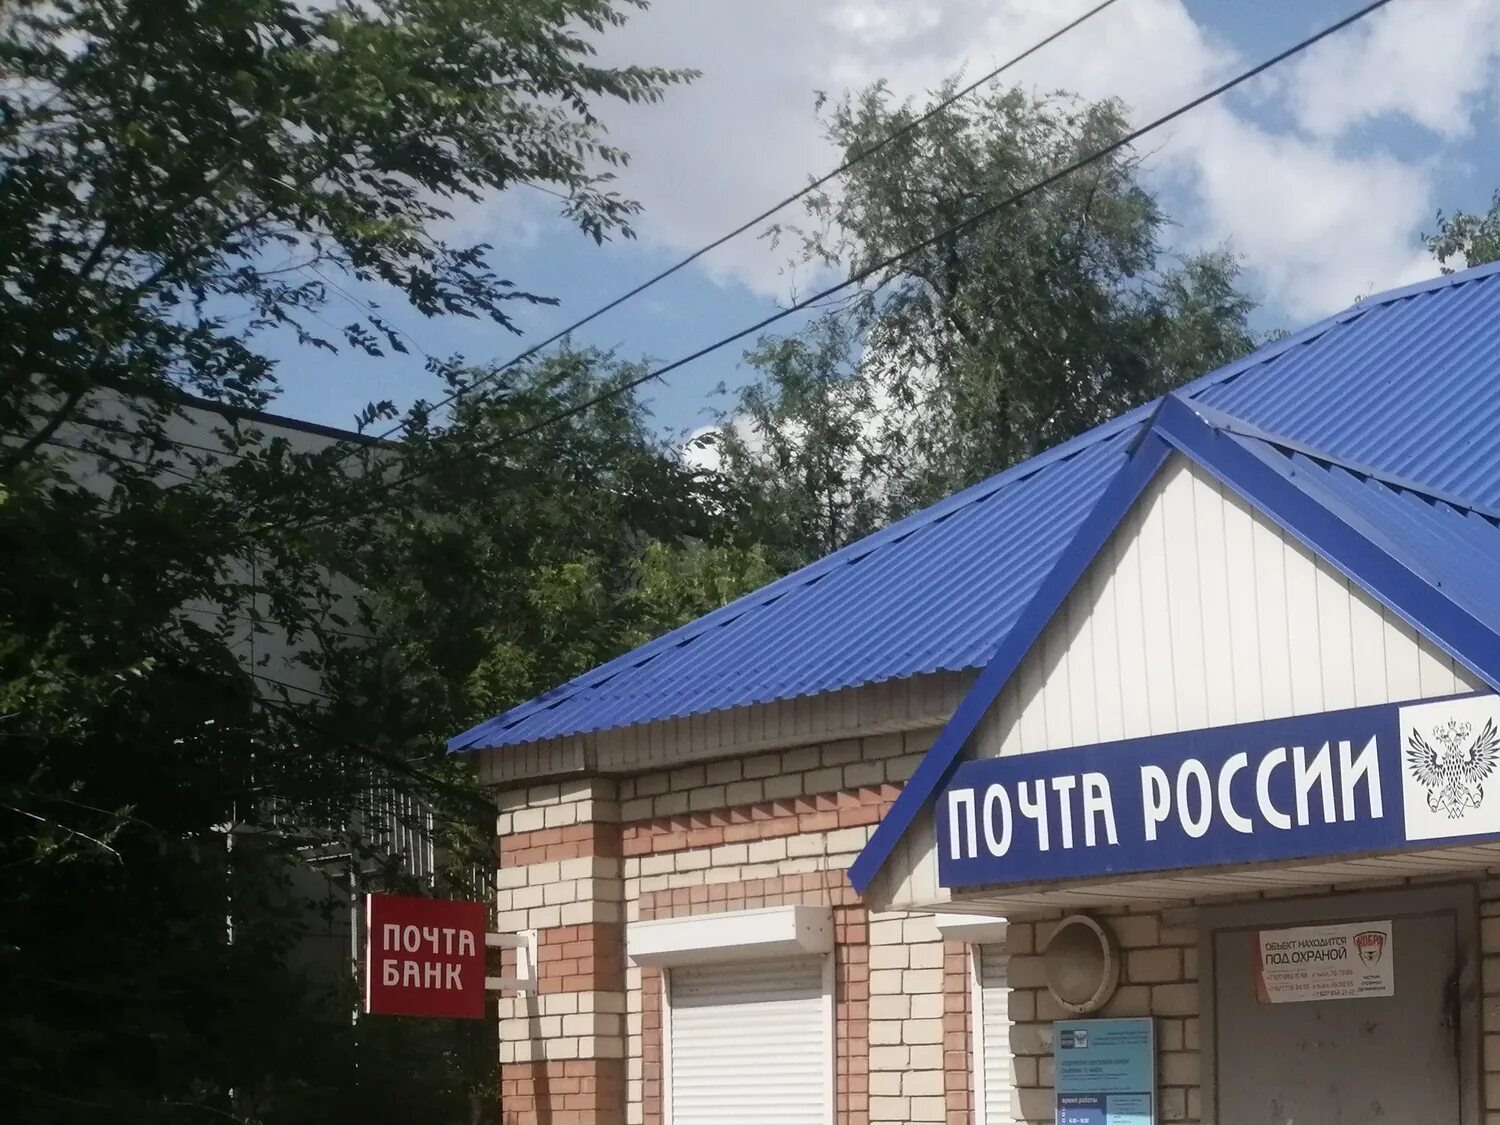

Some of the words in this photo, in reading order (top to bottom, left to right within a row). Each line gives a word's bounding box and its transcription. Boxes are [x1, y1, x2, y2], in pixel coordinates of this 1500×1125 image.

[948, 772, 1120, 861] ПОЧТА
[1141, 734, 1384, 841] РОССИИ
[383, 924, 476, 956] ПОЧТА
[1265, 940, 1297, 951] ОБЪЕКТ
[1298, 936, 1347, 949] НАХОДИТСЯ
[1265, 952, 1290, 965] ПОД
[1291, 947, 1347, 964] ОХРАНОЙ
[383, 959, 463, 990] БАНК
